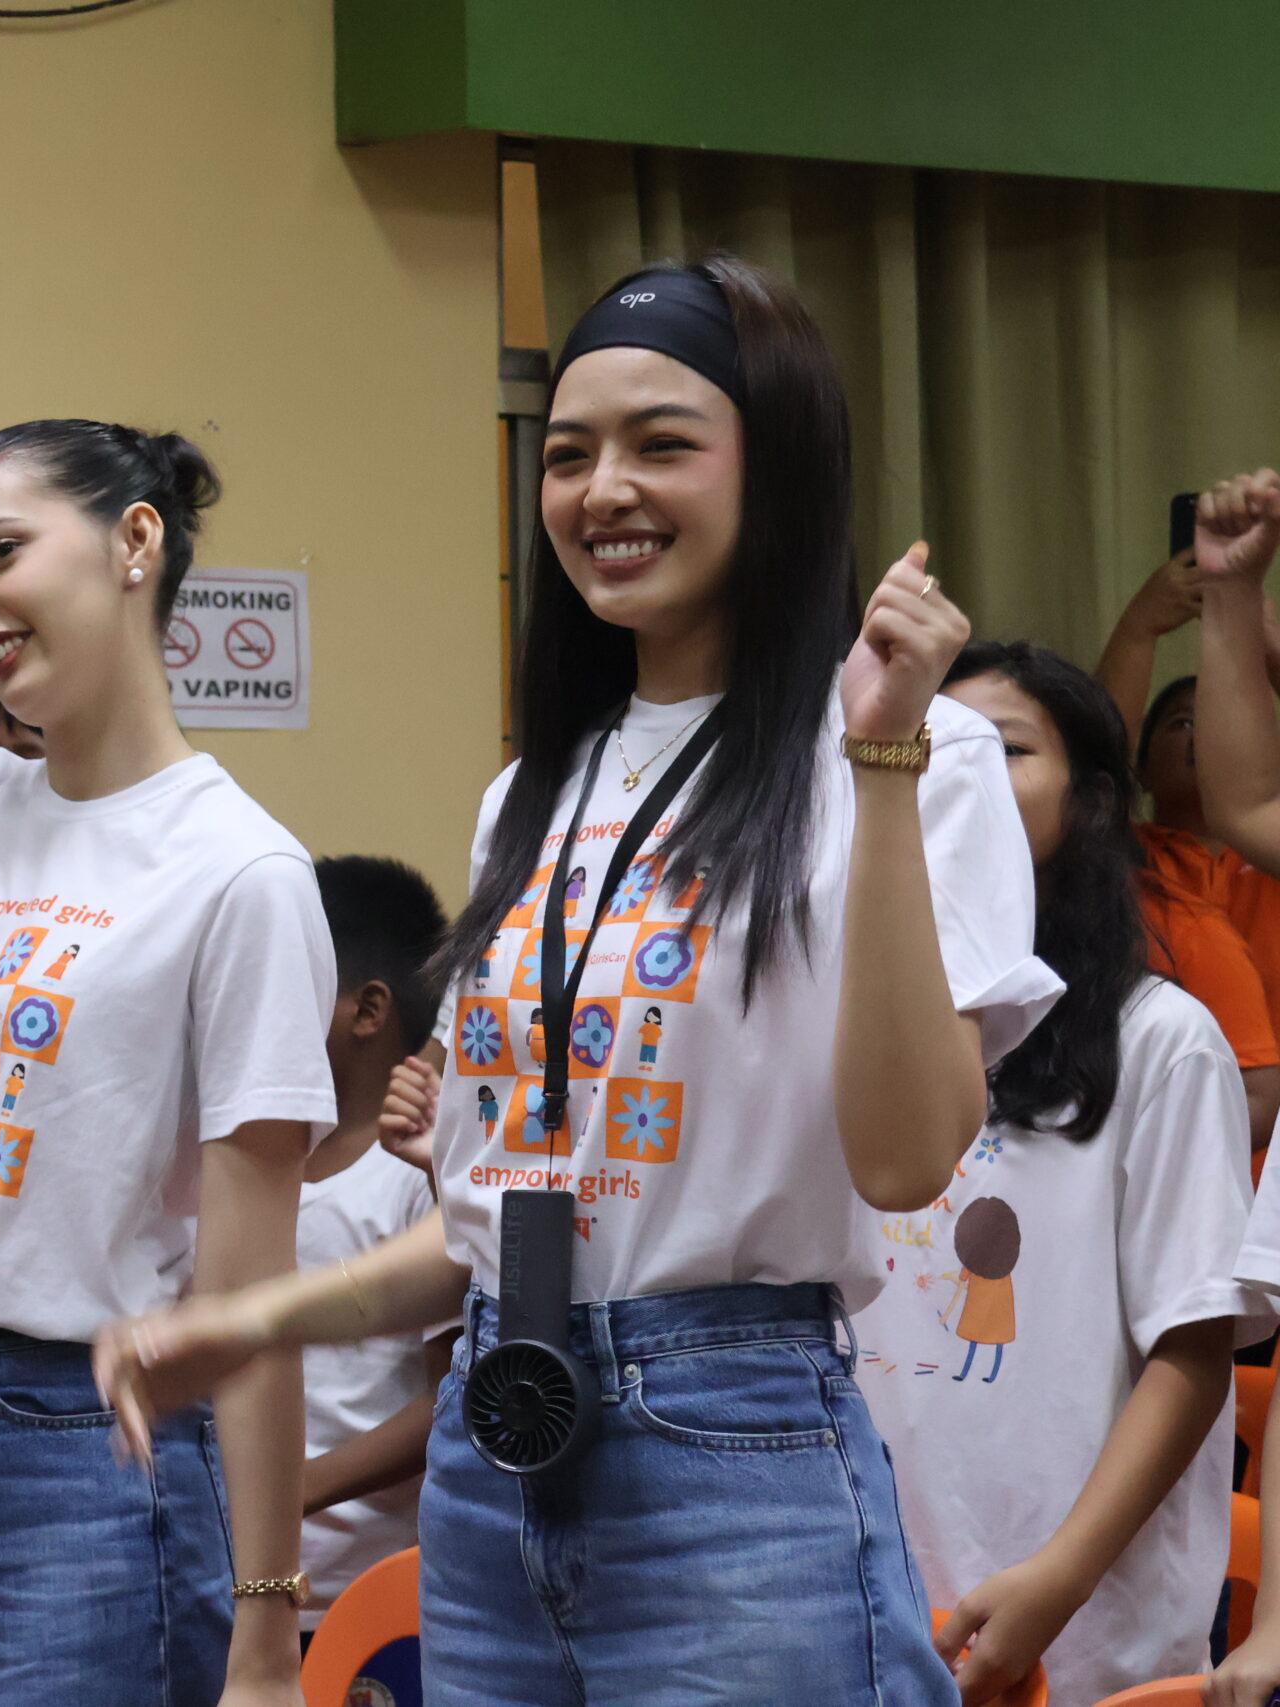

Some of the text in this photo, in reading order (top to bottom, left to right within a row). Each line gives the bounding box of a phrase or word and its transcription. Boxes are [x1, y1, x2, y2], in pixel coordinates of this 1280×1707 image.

[620, 292, 656, 309] alo
[175, 590, 292, 612] SMOKING
[183, 679, 293, 700] VAPING
[54, 904, 115, 929] girls
[470, 1165, 641, 1204] empowr girls
